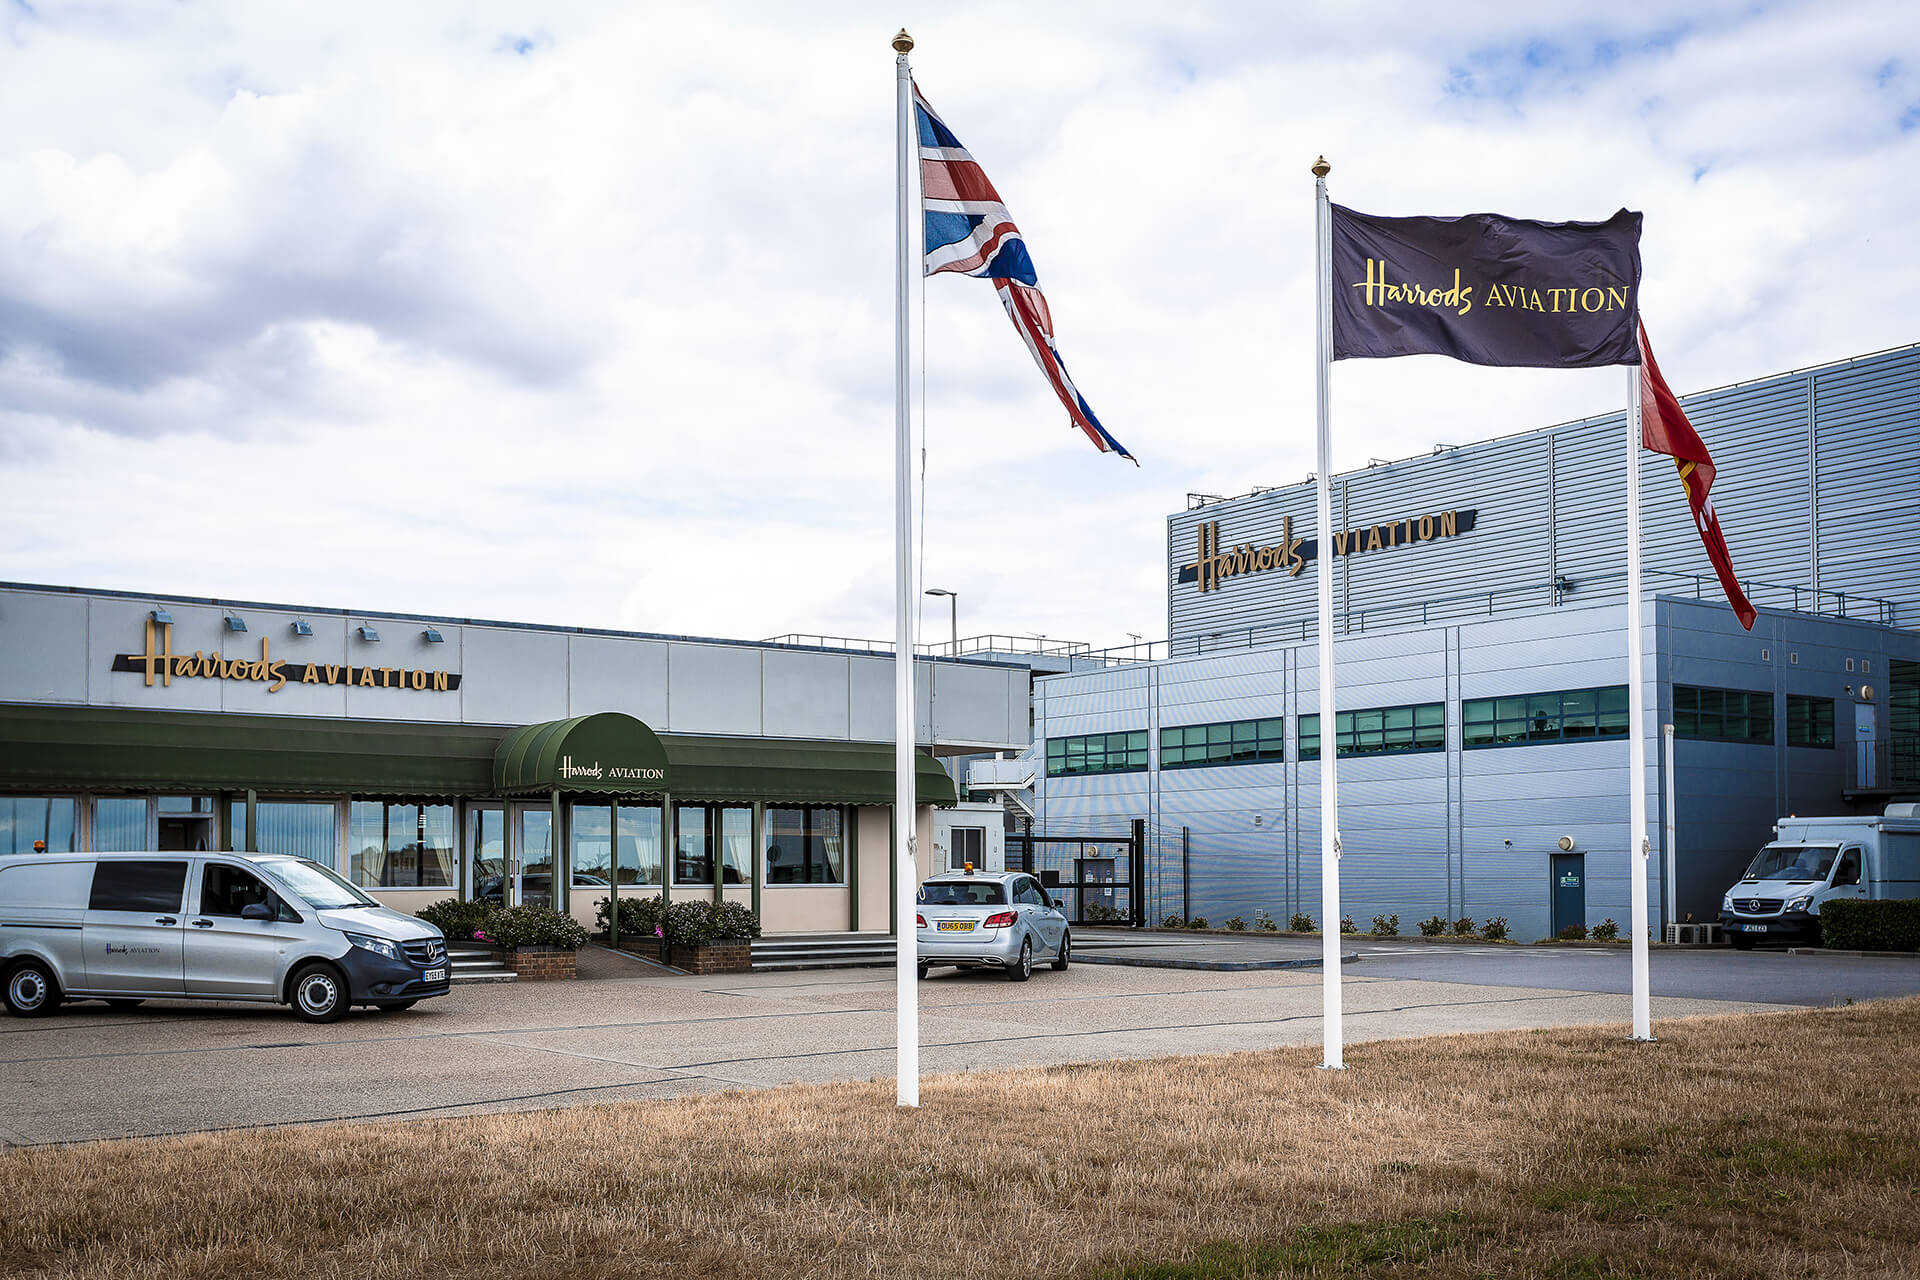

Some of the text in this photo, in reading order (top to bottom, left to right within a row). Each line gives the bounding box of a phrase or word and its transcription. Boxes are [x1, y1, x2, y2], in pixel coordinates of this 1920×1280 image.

[1352, 257, 1631, 316] Harrods AVIATION
[1185, 510, 1457, 593] Harrods VIATION
[127, 618, 448, 693] Harrods AVIATION
[558, 755, 664, 780] Harrods AVIATION
